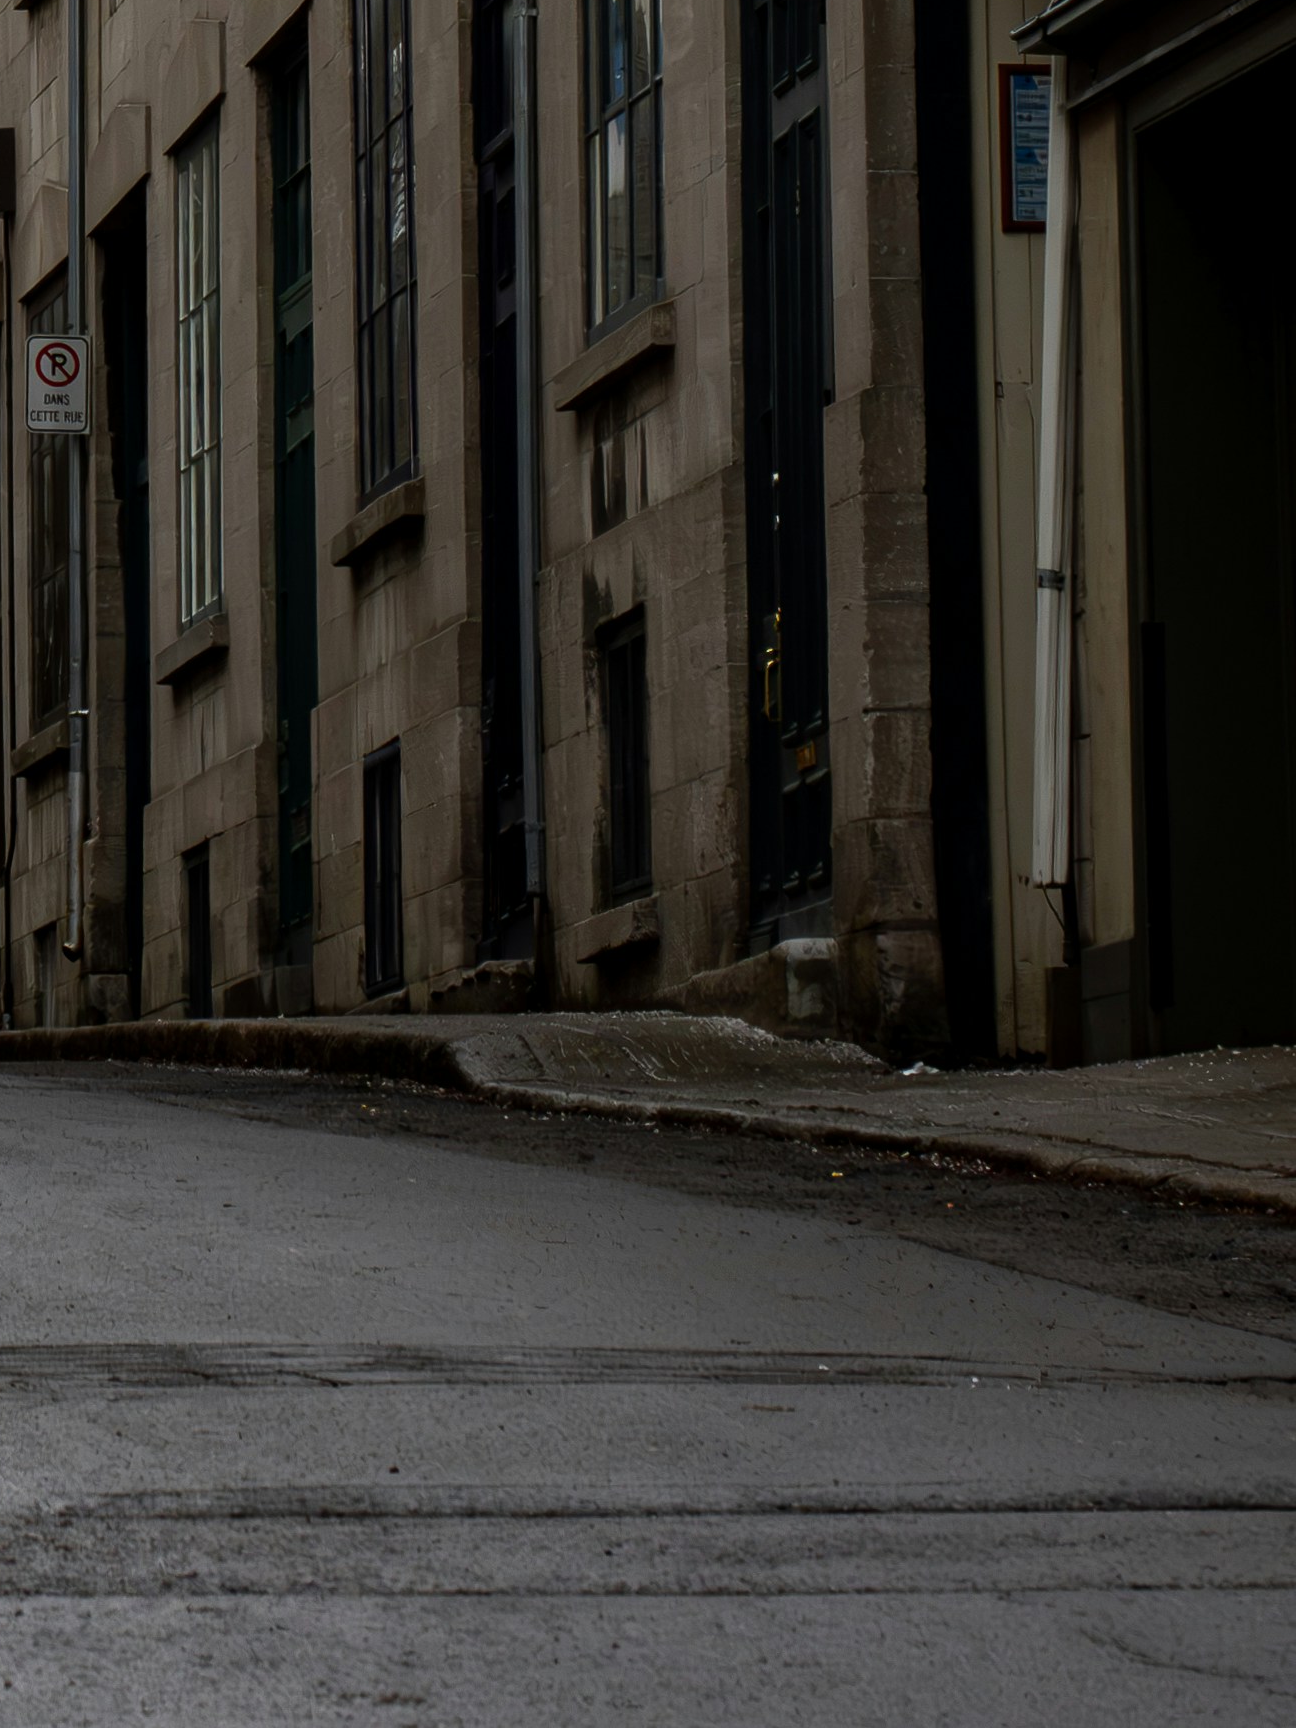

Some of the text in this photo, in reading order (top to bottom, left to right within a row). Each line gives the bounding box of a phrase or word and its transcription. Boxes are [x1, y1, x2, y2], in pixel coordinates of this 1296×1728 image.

[43, 393, 70, 406] DANS
[30, 409, 84, 423] CETTE RUE
